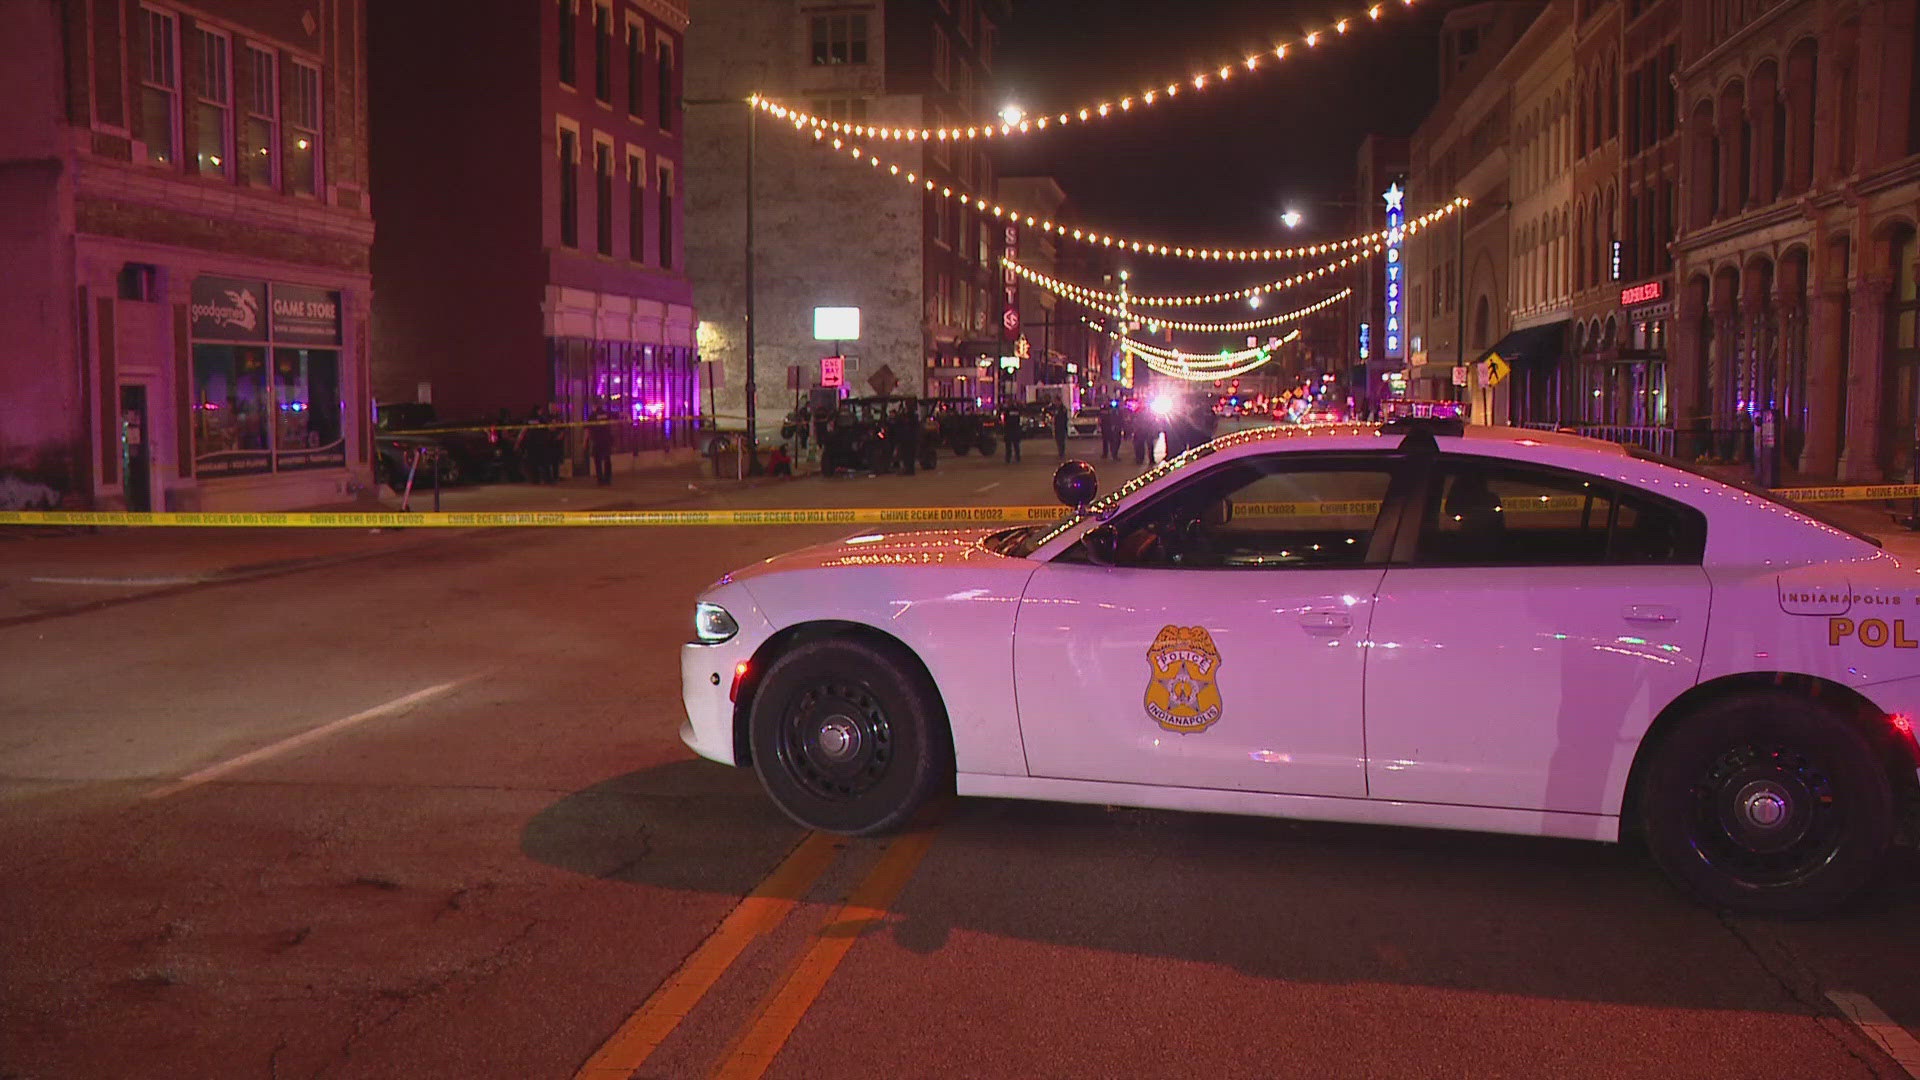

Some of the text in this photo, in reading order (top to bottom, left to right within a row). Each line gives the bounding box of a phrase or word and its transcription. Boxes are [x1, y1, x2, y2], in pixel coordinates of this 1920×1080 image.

[273, 298, 336, 320] GAME STORE
[1782, 593, 1902, 606] INDIANAPOLIS
[1828, 617, 1919, 649] POL
[1160, 650, 1209, 668] POLICE
[1149, 704, 1218, 725] INDIANAPOLIS
